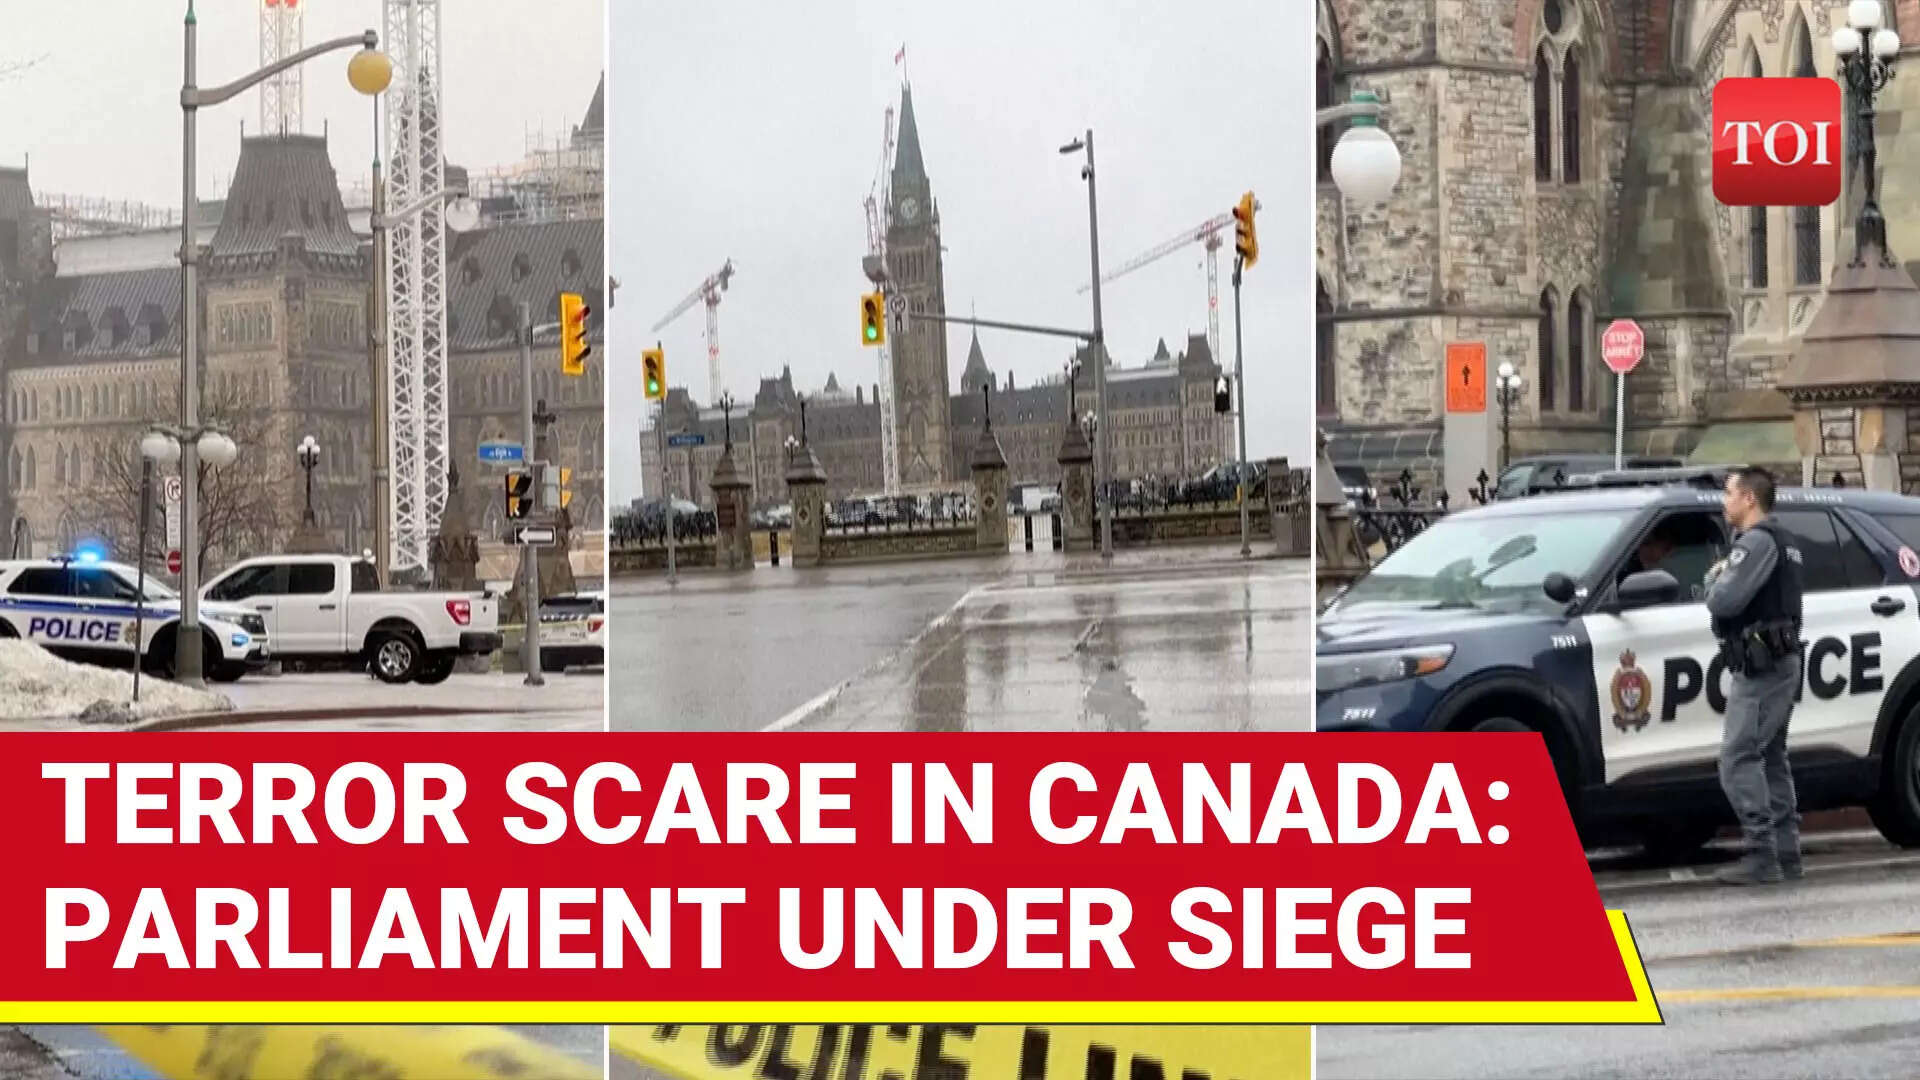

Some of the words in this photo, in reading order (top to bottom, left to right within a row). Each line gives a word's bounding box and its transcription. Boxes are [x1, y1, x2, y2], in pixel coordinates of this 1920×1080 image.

[1608, 331, 1637, 345] STOP
[28, 617, 122, 642] POLICE
[1661, 631, 1883, 722] POCE
